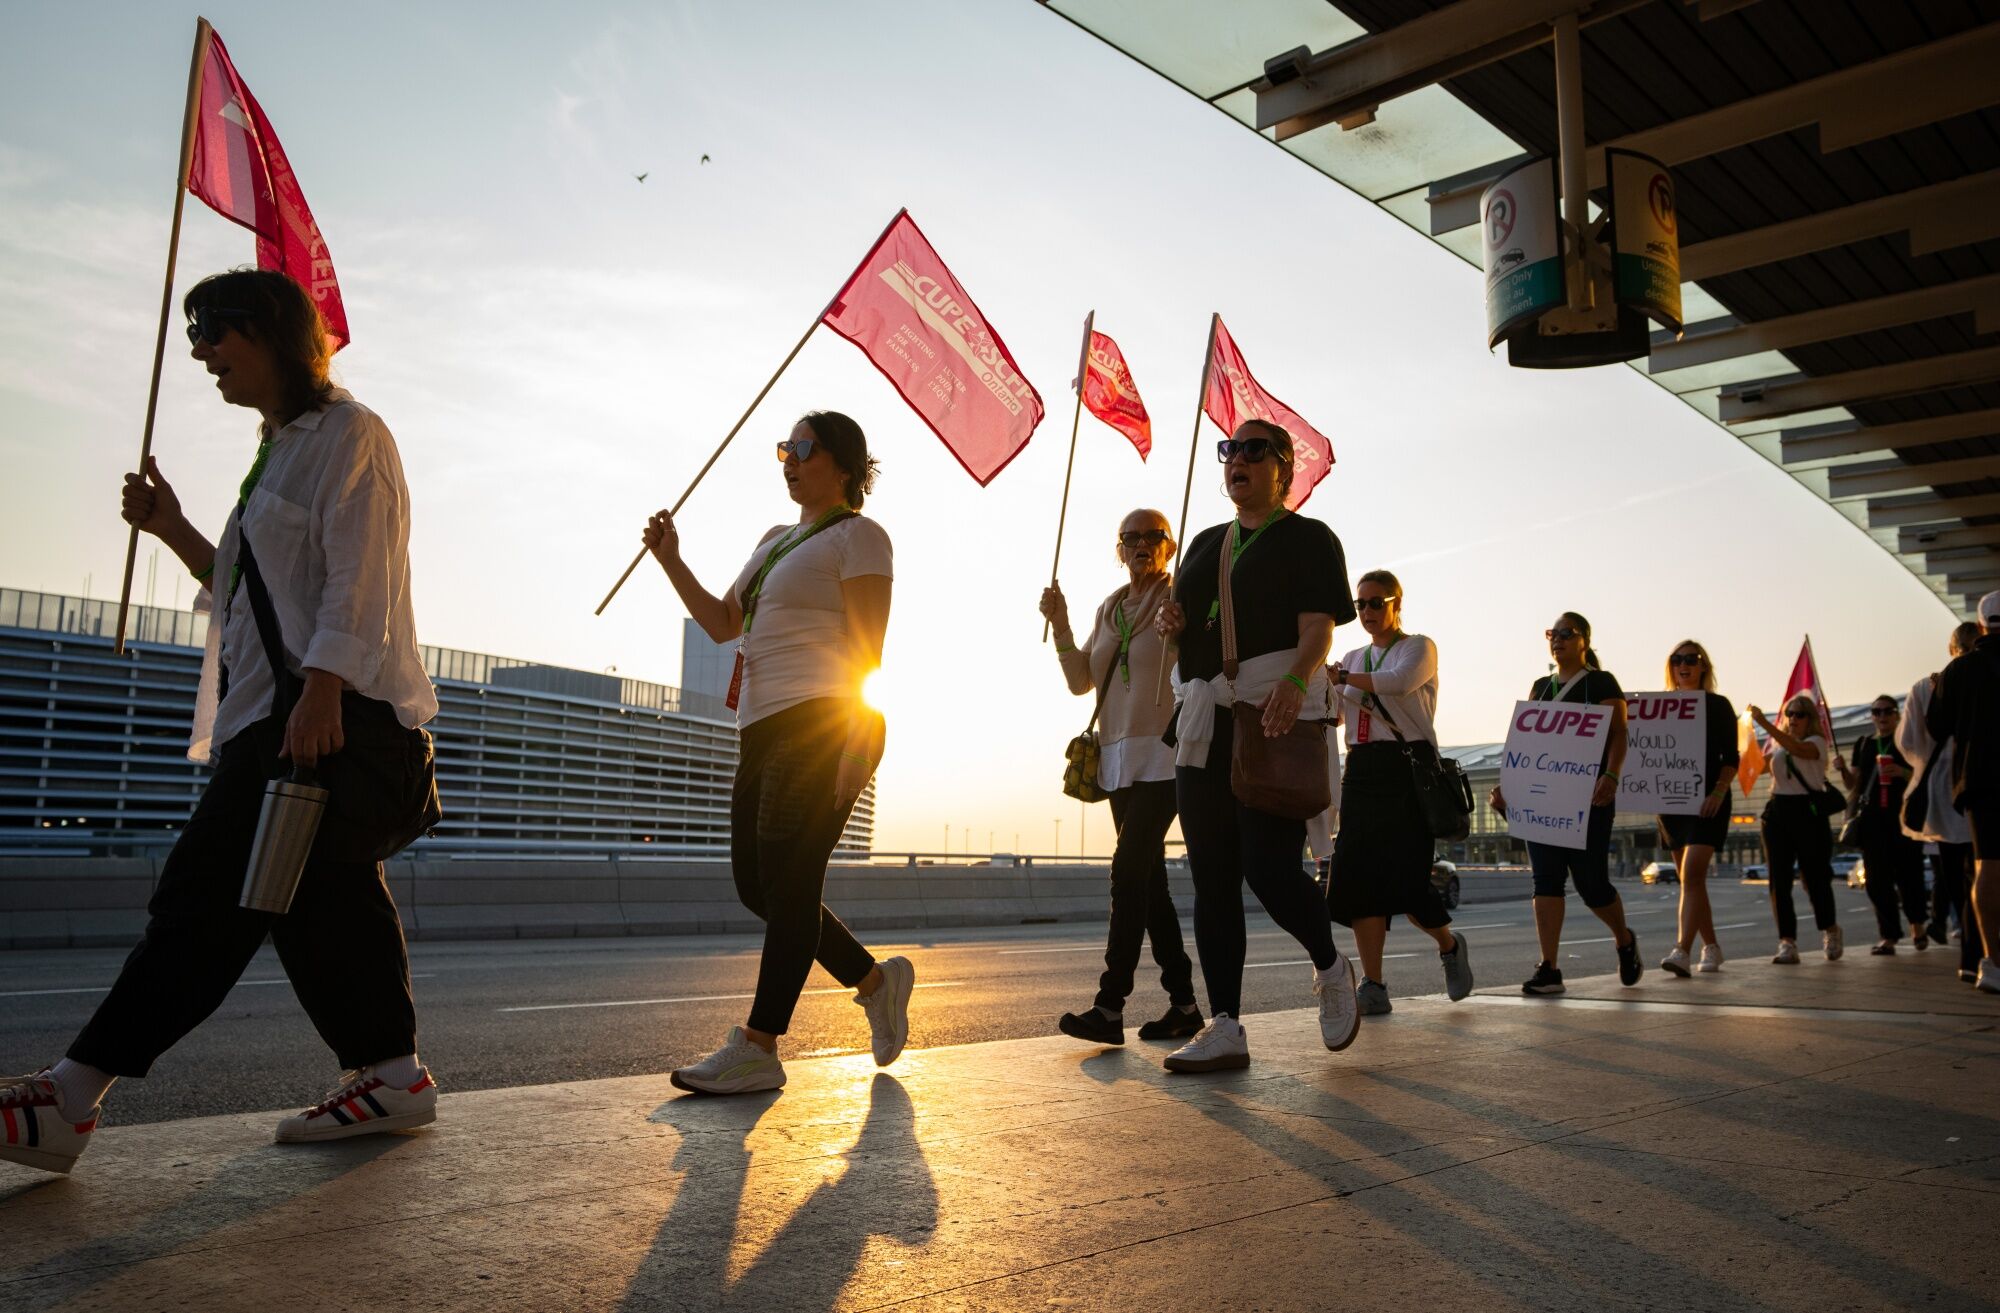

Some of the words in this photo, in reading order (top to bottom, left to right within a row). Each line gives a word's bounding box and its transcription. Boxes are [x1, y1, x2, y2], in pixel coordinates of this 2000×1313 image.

[1511, 269, 1533, 285] Only
[893, 332, 909, 346] FOR
[900, 324, 936, 360] FIGHTING
[914, 276, 977, 335] CUPE
[981, 346, 1034, 399] SCFP
[982, 371, 1018, 412] Ontario
[1516, 708, 1604, 738] CUPE
[1626, 728, 1676, 749] WOULD
[1536, 753, 1600, 777] CONTRACT
[1640, 752, 1662, 768] YOU
[1664, 752, 1698, 771] WORK
[1622, 774, 1650, 793] FOR
[1656, 773, 1703, 797] FREE?
